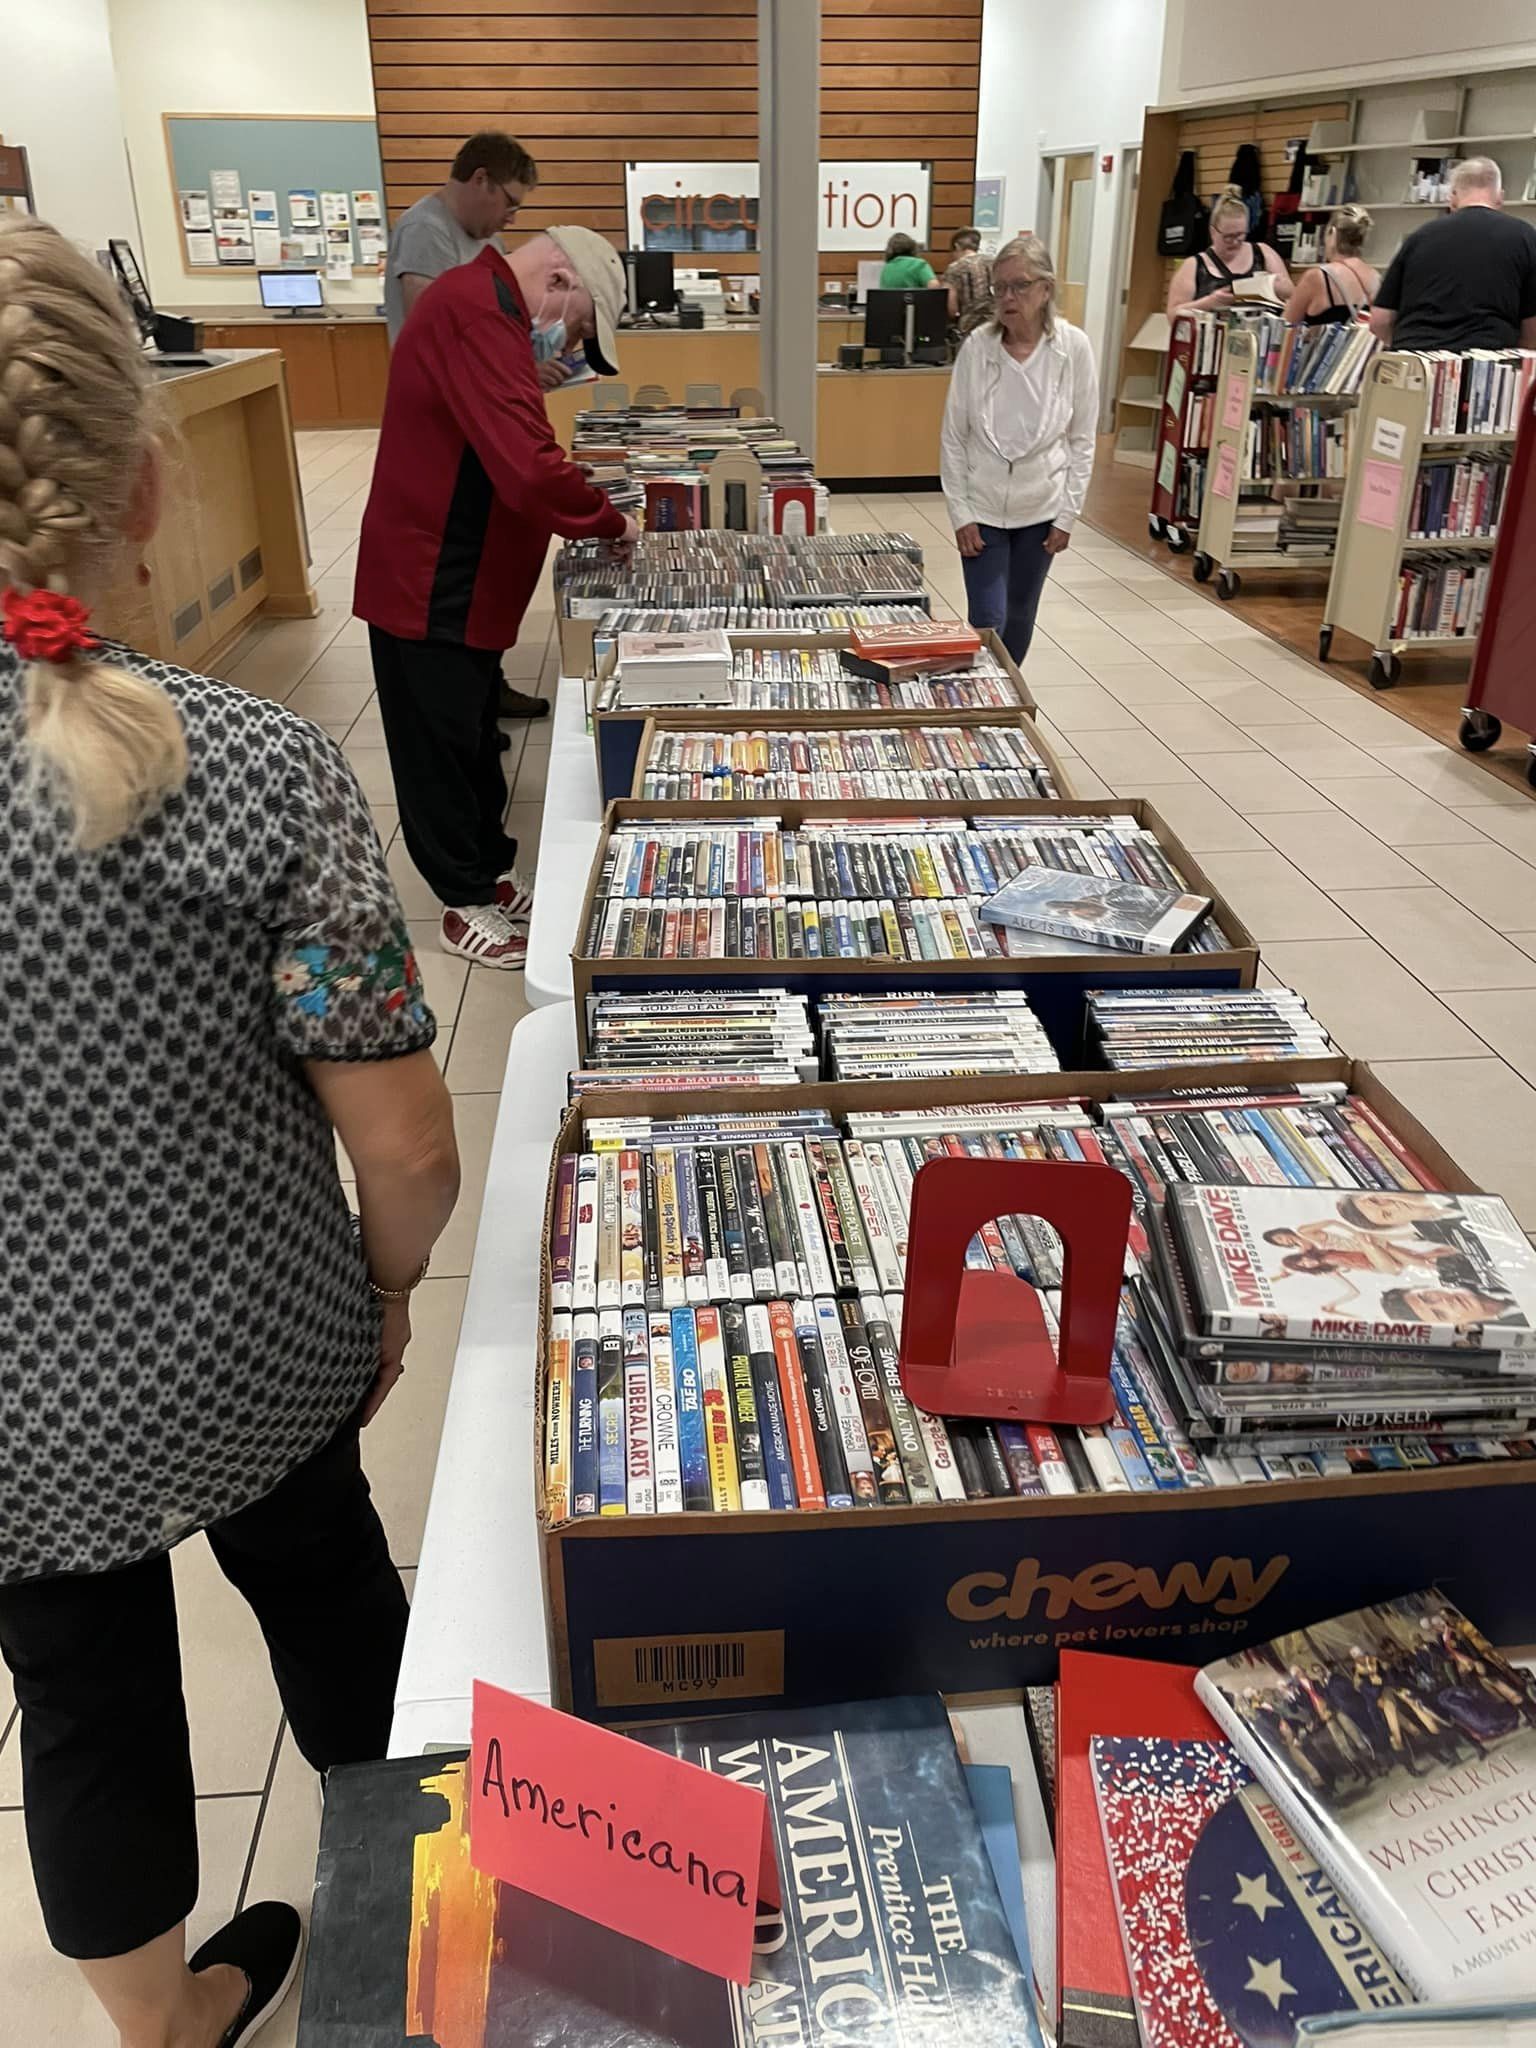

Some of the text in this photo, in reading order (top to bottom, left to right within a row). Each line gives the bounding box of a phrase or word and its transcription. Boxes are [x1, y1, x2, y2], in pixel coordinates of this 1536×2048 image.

[640, 180, 917, 231] circution
[1062, 924, 1099, 941] LOST
[886, 991, 935, 999] RISEN
[857, 1184, 881, 1238] SNIPER
[1230, 1189, 1246, 1221] DATES
[1206, 1189, 1265, 1307] MIKE DAVE
[1312, 1319, 1433, 1338] MIKE DAVE
[551, 1380, 562, 1421] NOWHERE
[654, 1355, 675, 1451] LARRY CROWNE
[682, 1368, 697, 1411] TAE BO
[732, 1355, 757, 1423] PRIVATE NUMBER
[880, 1347, 919, 1452] ONLY THE BRAVE
[579, 1398, 593, 1453] THE TURNING
[628, 1373, 650, 1478] LIBERAL ARTS
[1129, 1404, 1160, 1445] BABAR
[1336, 1412, 1377, 1428] NED
[1382, 1408, 1433, 1425] KELLY
[550, 1437, 559, 1465] MILES
[772, 1426, 786, 1461] AMERICAN
[930, 1426, 951, 1469] Garage
[946, 1555, 1291, 1621] chewy
[969, 1617, 1249, 1649] where pet lovers shop
[663, 1678, 718, 1692] MC99
[1388, 1754, 1520, 1819] GENERAL
[482, 1737, 748, 1906] Americana
[1256, 1803, 1295, 1849] GREAT
[922, 1875, 968, 1955] THE
[1451, 1963, 1466, 1979] A
[1464, 1937, 1521, 1974] MOUNT
